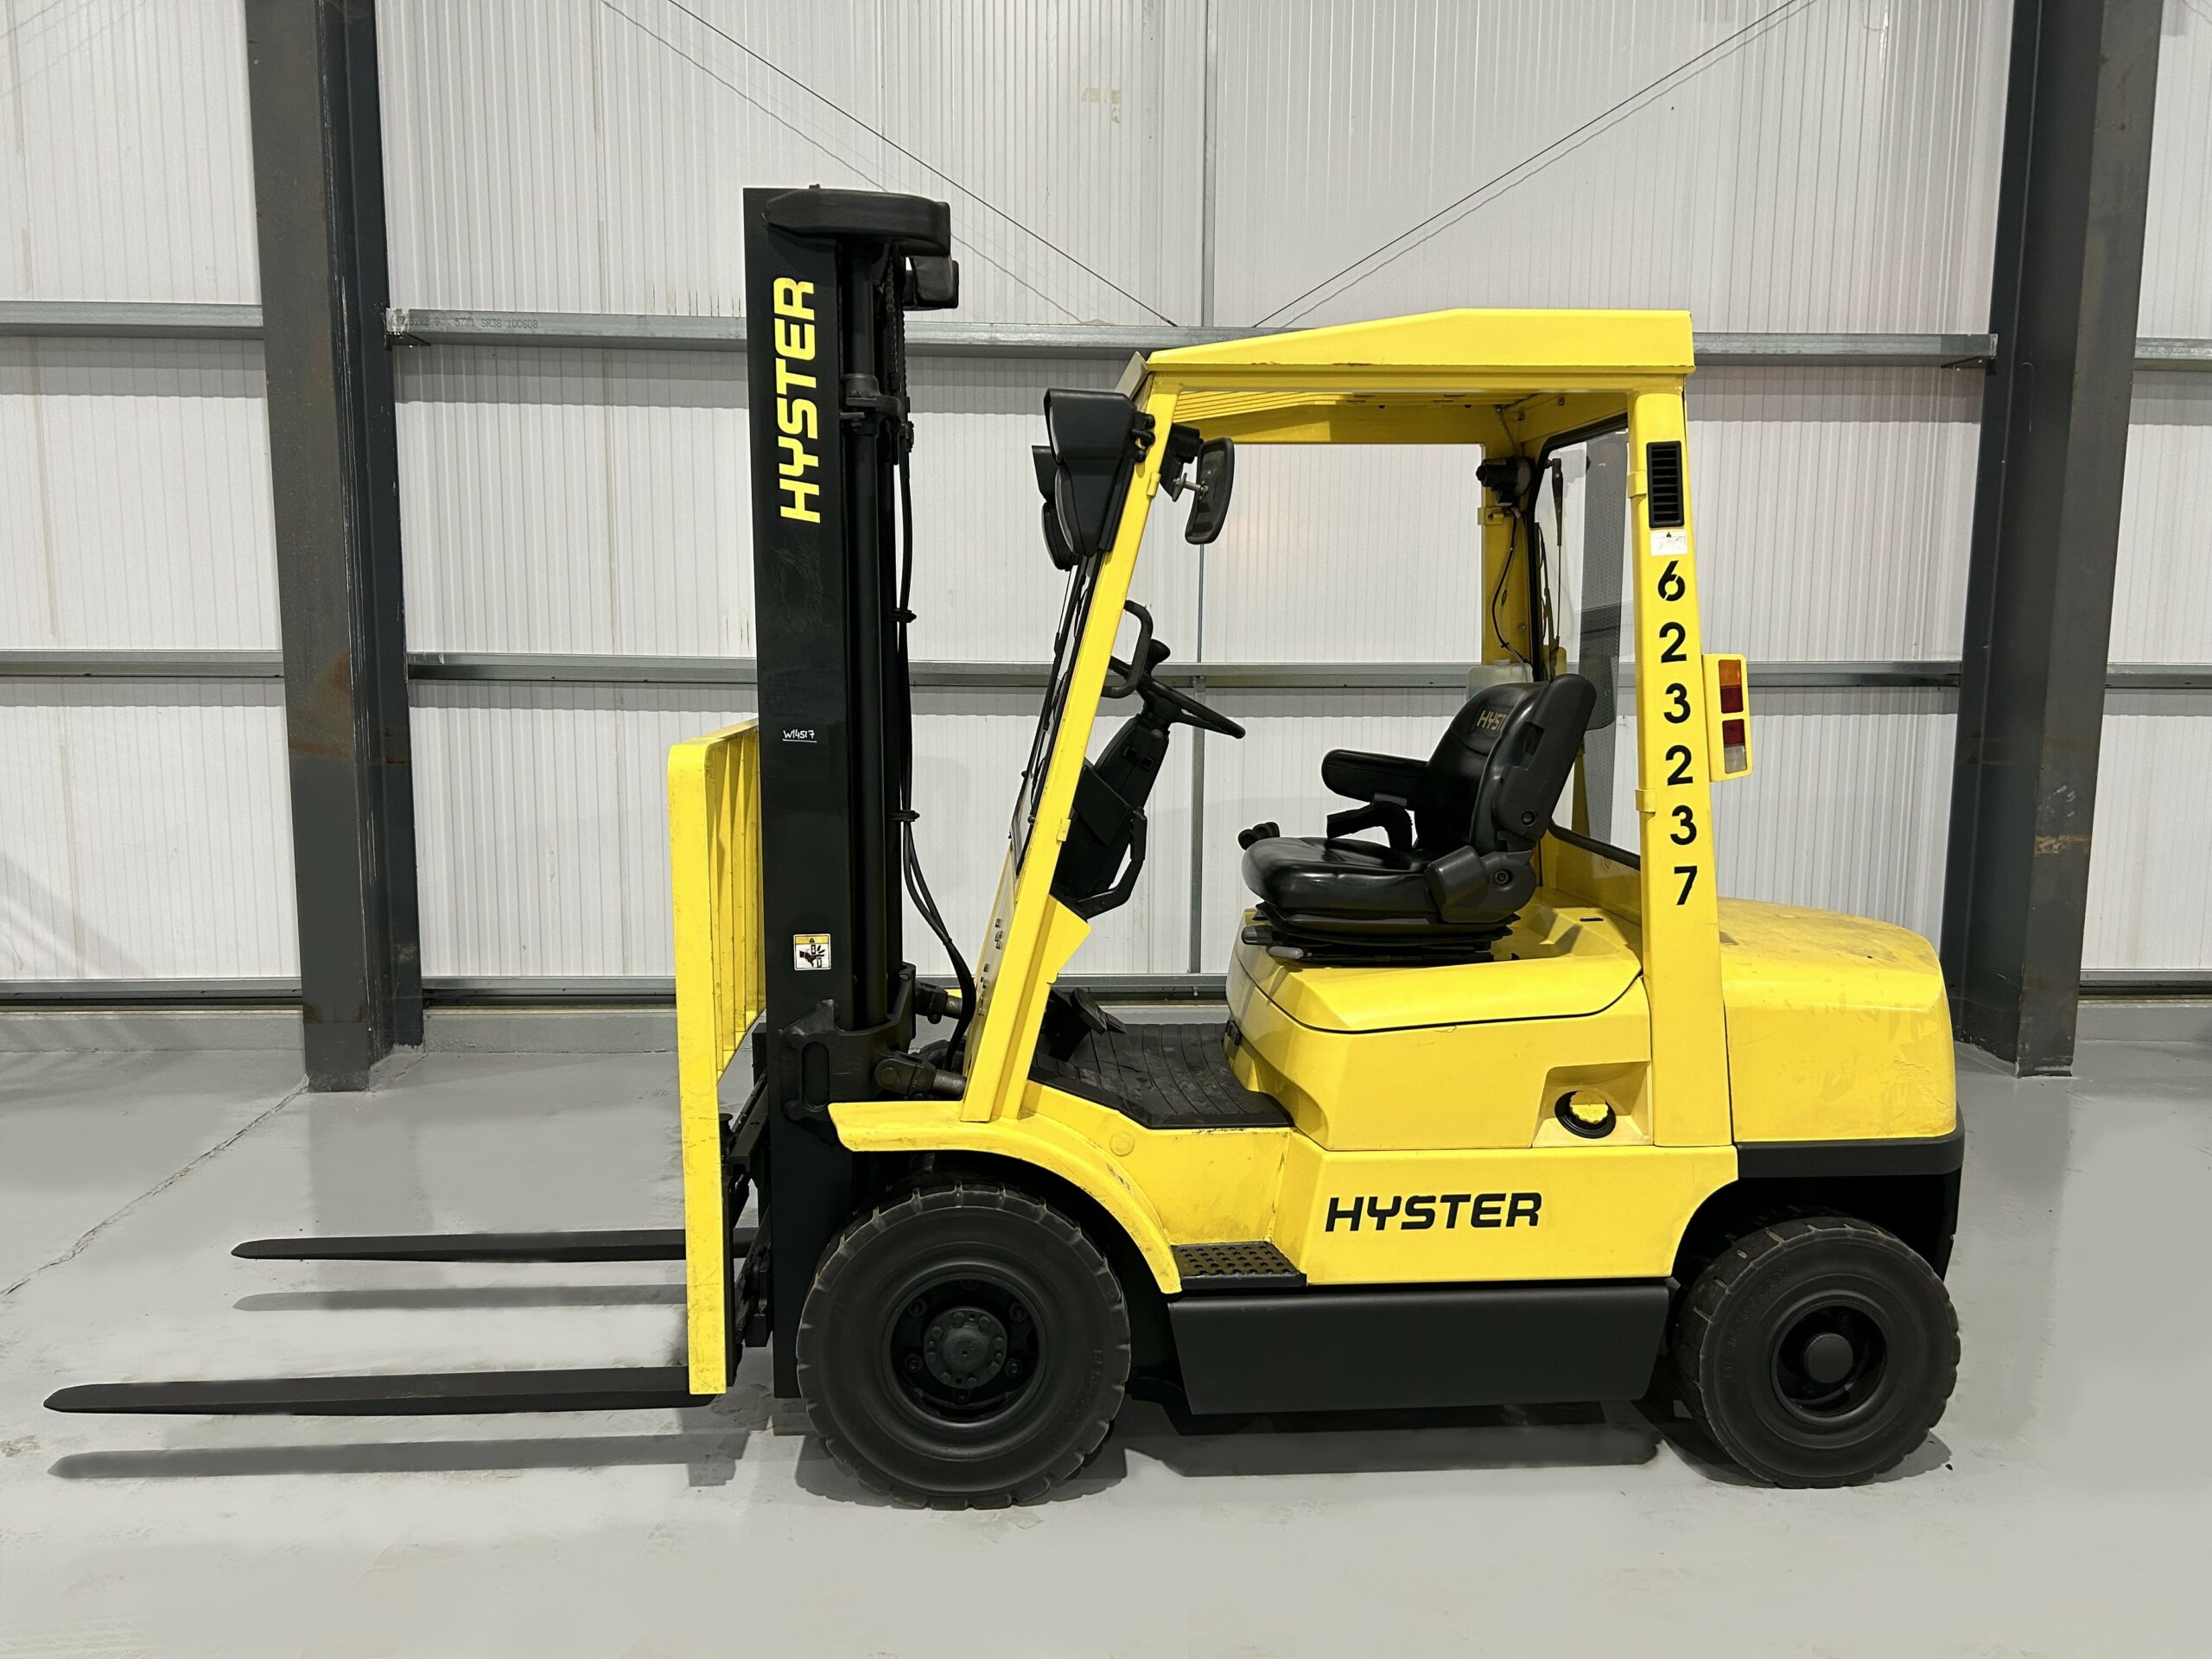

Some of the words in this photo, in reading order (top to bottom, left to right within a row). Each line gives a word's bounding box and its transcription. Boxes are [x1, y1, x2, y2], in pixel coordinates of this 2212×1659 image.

[773, 277, 821, 523] HYSTER
[783, 729, 815, 740] W14517
[1325, 1192, 1542, 1232] HYSTER
